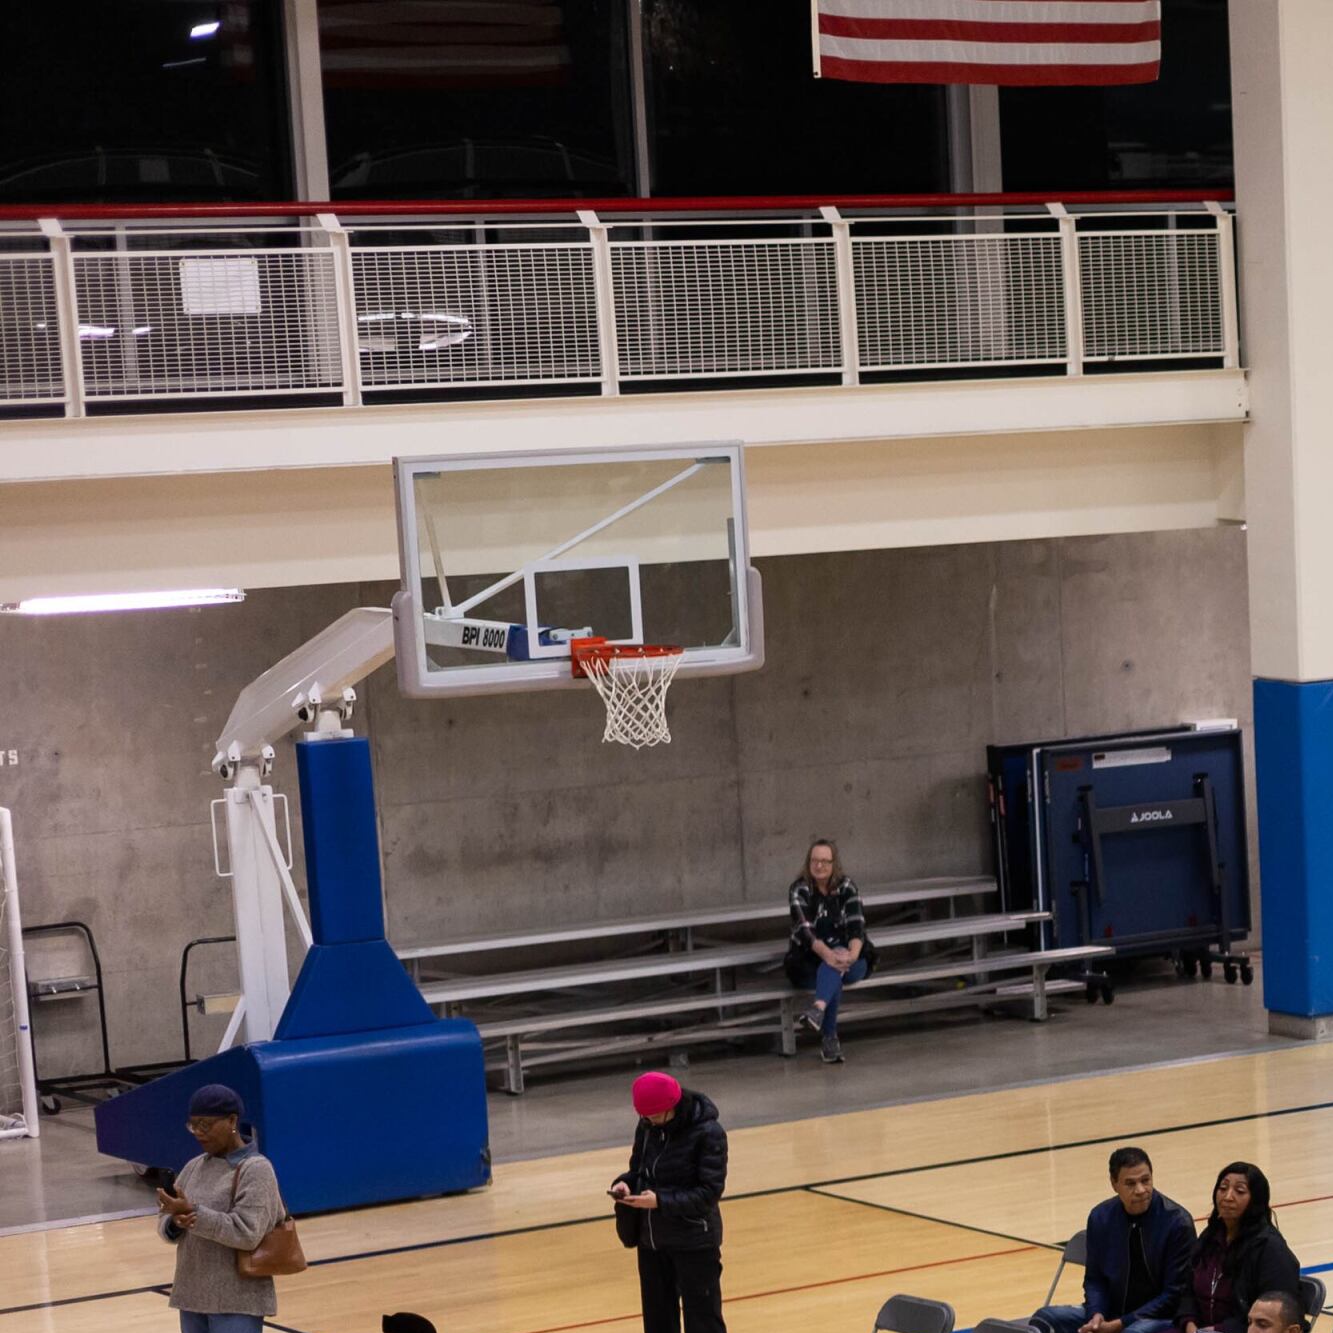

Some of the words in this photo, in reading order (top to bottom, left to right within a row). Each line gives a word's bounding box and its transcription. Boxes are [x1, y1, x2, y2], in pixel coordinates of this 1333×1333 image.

[462, 626, 480, 646] BPI
[483, 628, 505, 648] 8000
[1140, 809, 1173, 821] JOOLA
